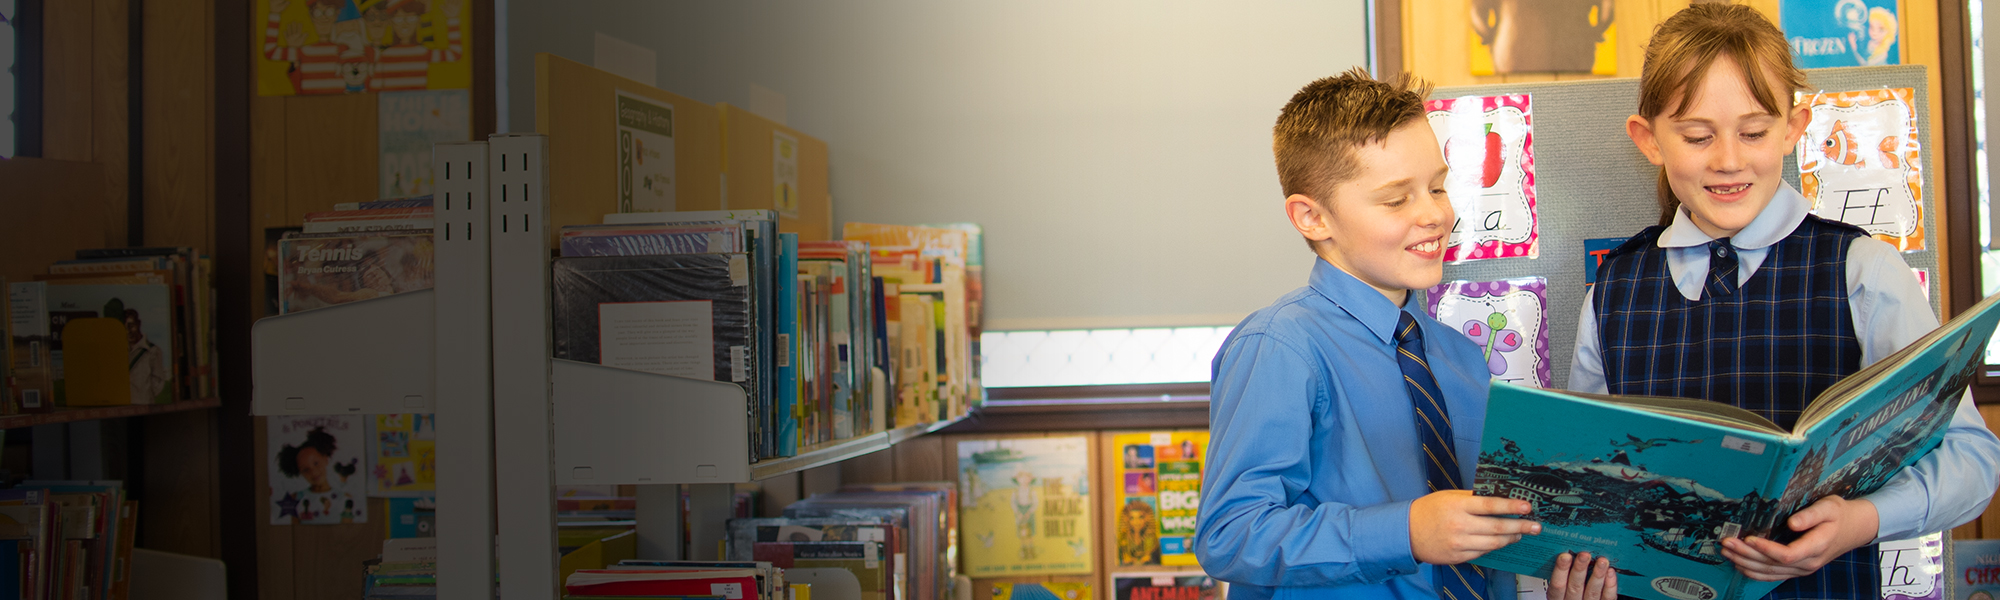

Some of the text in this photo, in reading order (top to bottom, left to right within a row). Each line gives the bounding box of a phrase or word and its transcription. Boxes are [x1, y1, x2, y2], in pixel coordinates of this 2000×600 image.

[1790, 36, 1846, 56] FROZEN
[620, 102, 647, 128] Geography
[296, 244, 363, 262] Tennis
[297, 265, 357, 275] Bryan Cutress
[1847, 375, 1935, 448] TIMELINE
[1044, 498, 1083, 516] ANZAC
[1160, 490, 1199, 510] BIG
[1543, 526, 1618, 547] history of our planet
